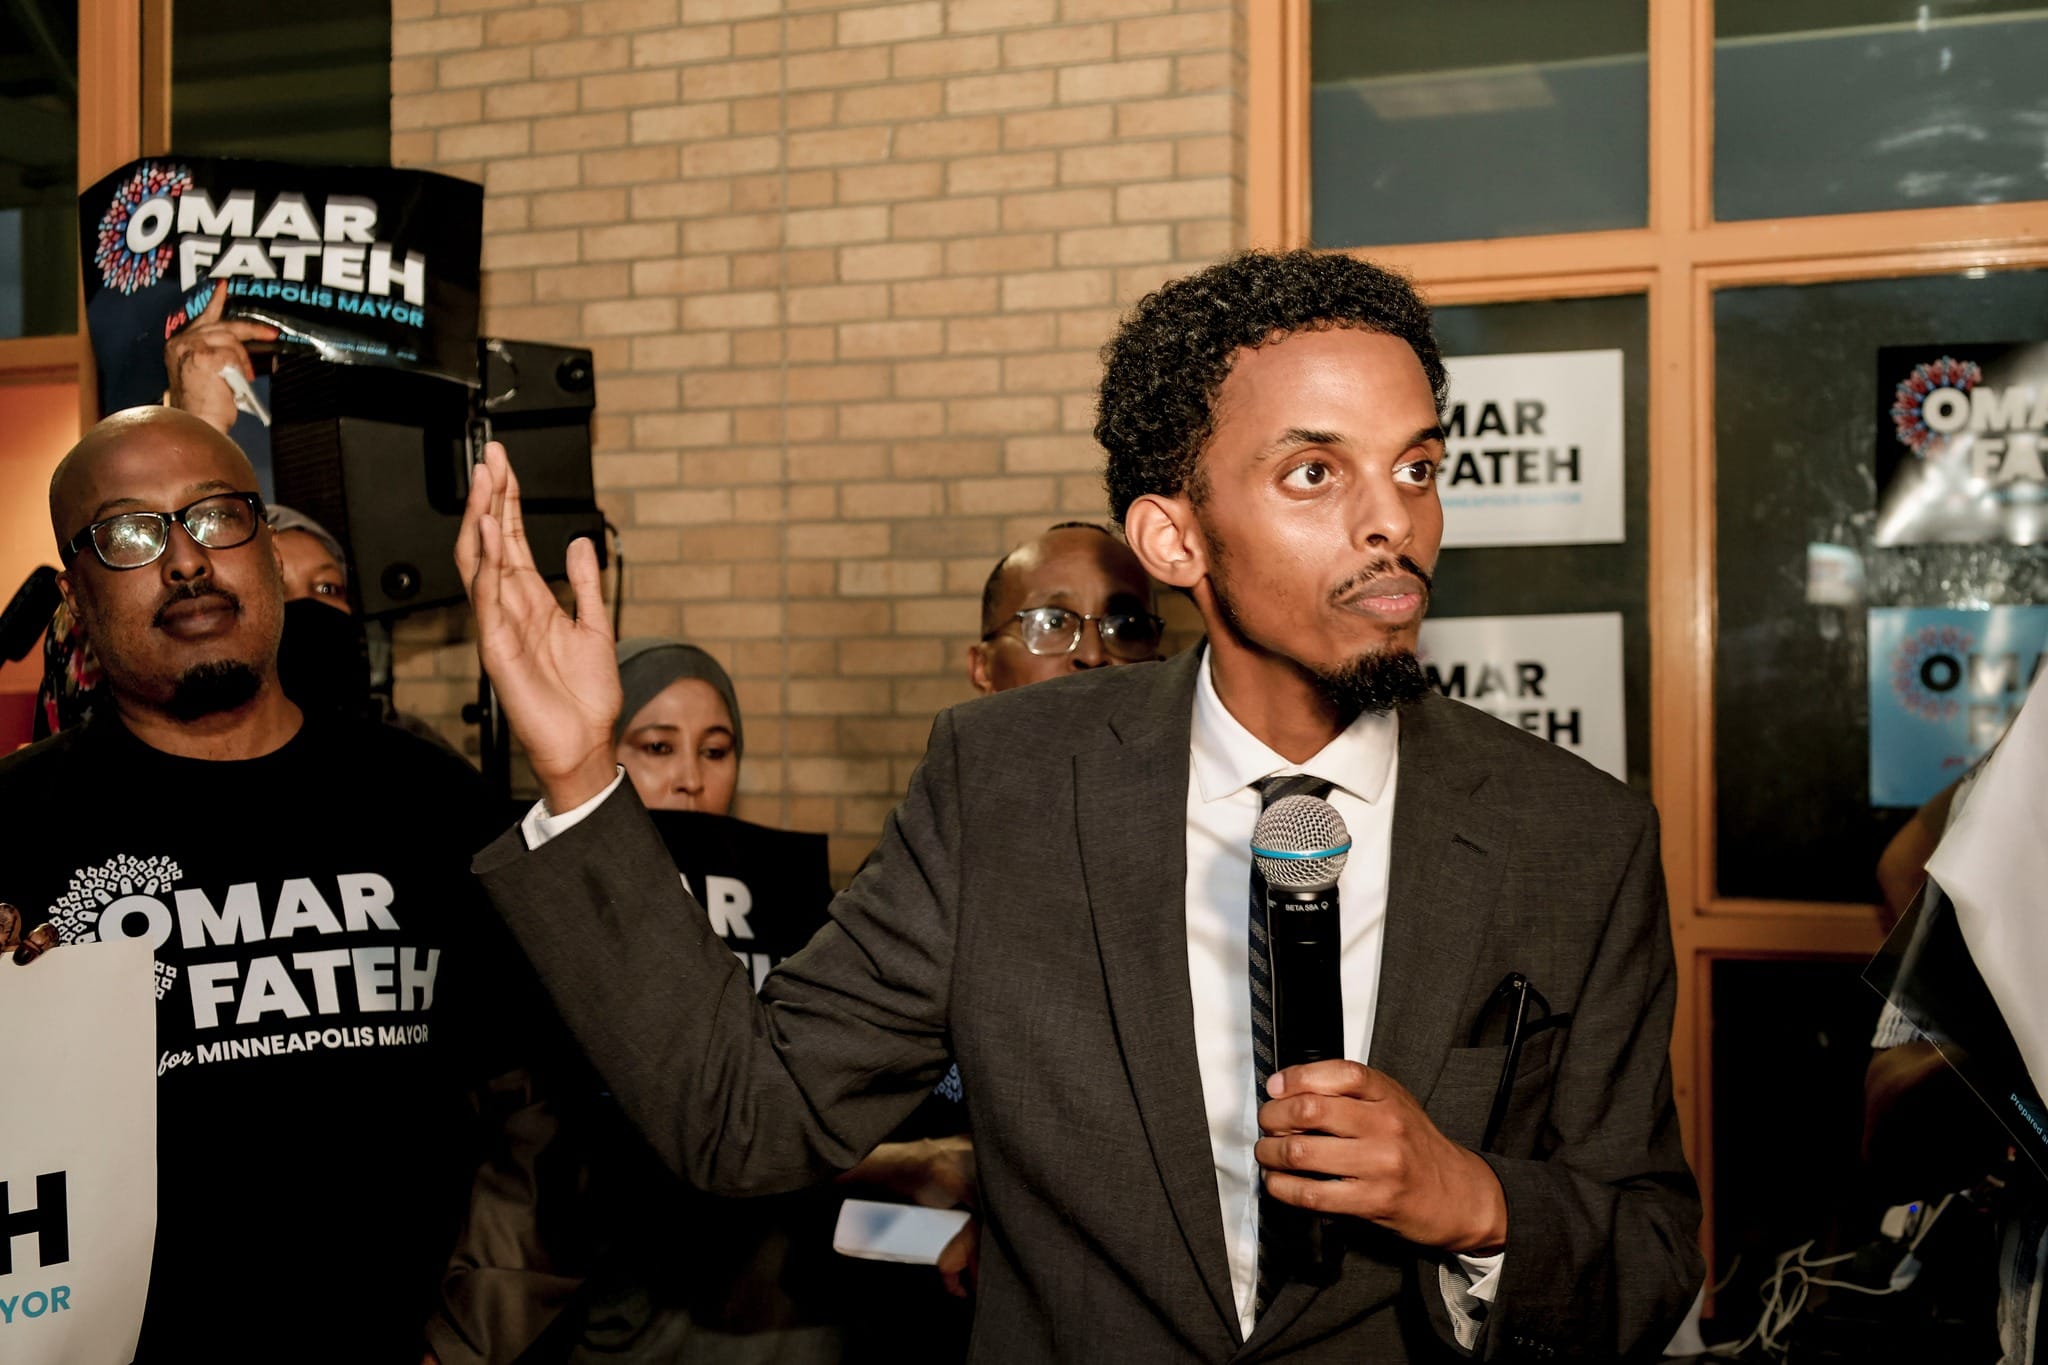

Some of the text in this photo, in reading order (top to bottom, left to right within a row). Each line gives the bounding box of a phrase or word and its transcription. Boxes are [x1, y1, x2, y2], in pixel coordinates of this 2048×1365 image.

[126, 189, 377, 254] OMAR
[179, 233, 425, 306] FATEH
[164, 309, 186, 341] for
[338, 294, 425, 328] MAYOR
[1438, 444, 1581, 487] ATEH
[1971, 432, 2048, 482] FA
[98, 872, 401, 953] OMAR
[187, 946, 441, 1029] FATEH
[157, 1023, 429, 1077] for MINNEAPOLIS MAYOR
[2010, 1092, 2043, 1135] Prepared
